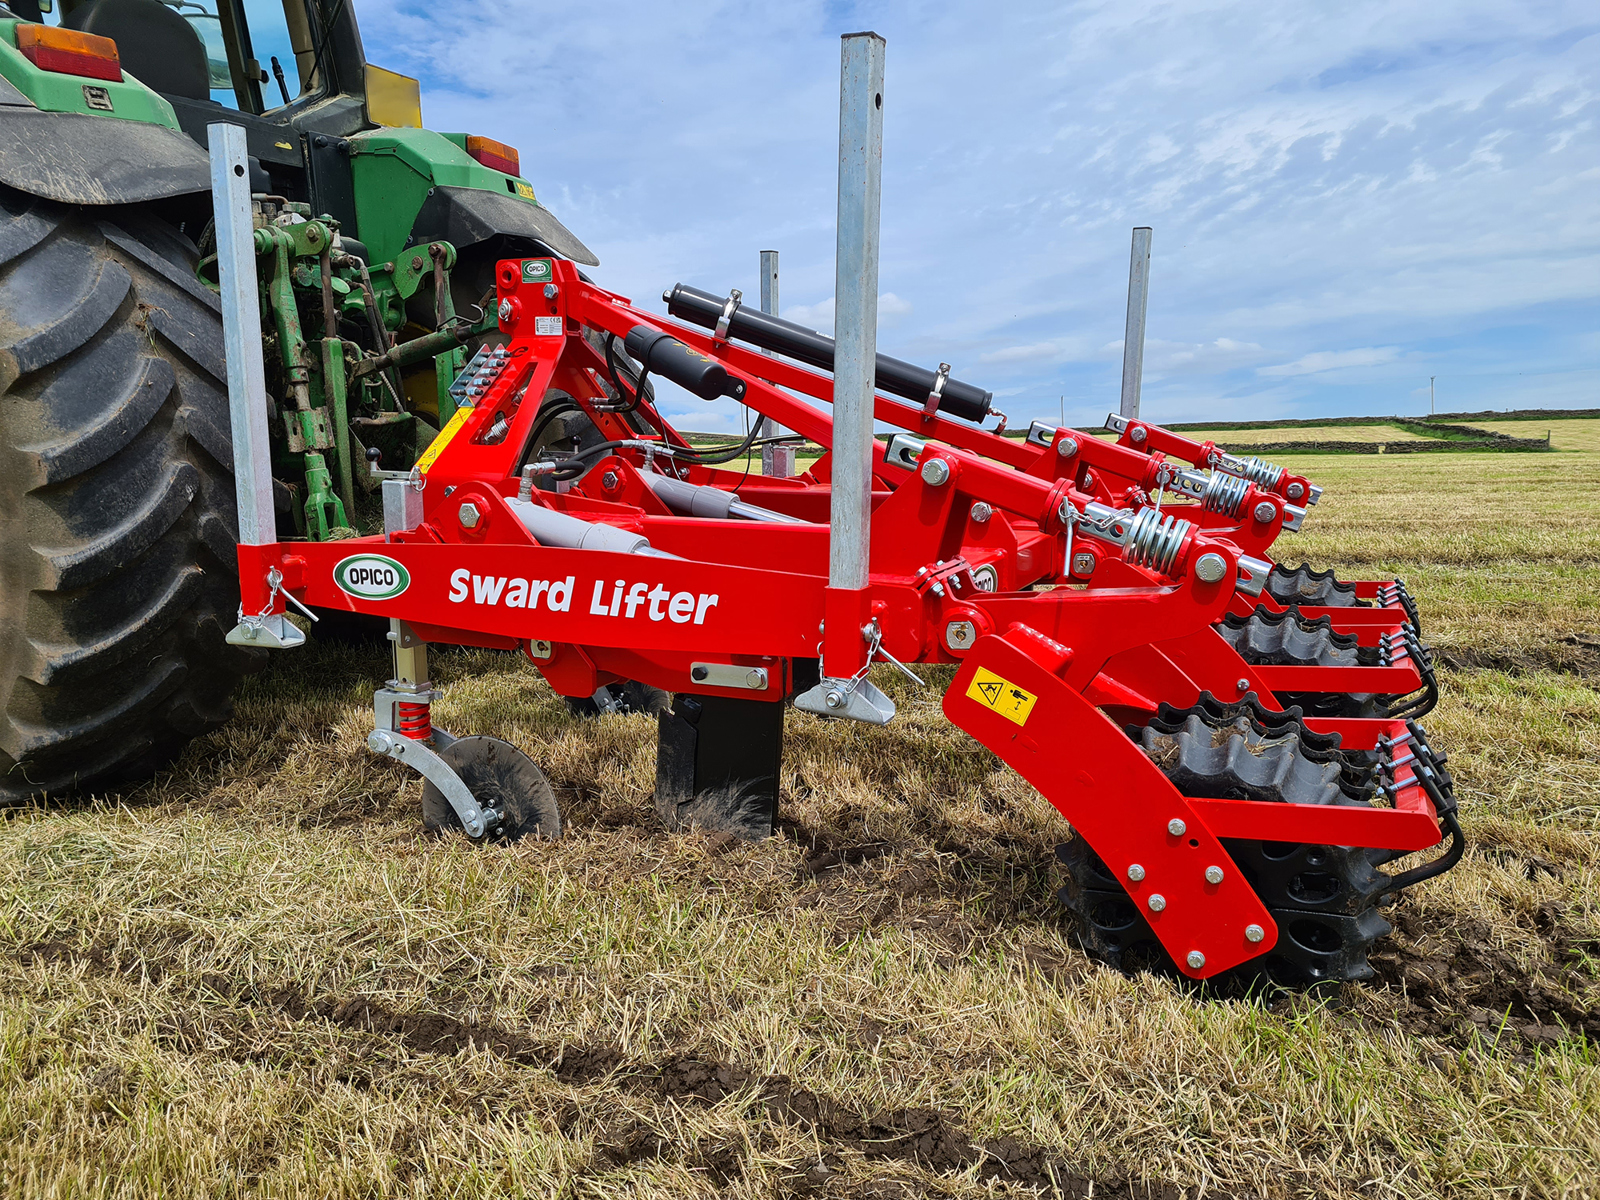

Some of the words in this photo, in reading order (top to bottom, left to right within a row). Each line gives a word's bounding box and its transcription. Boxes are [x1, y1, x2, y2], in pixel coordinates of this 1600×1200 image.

[349, 567, 394, 586] OPICO
[448, 567, 576, 613] Sward
[589, 579, 719, 625] Lifter
